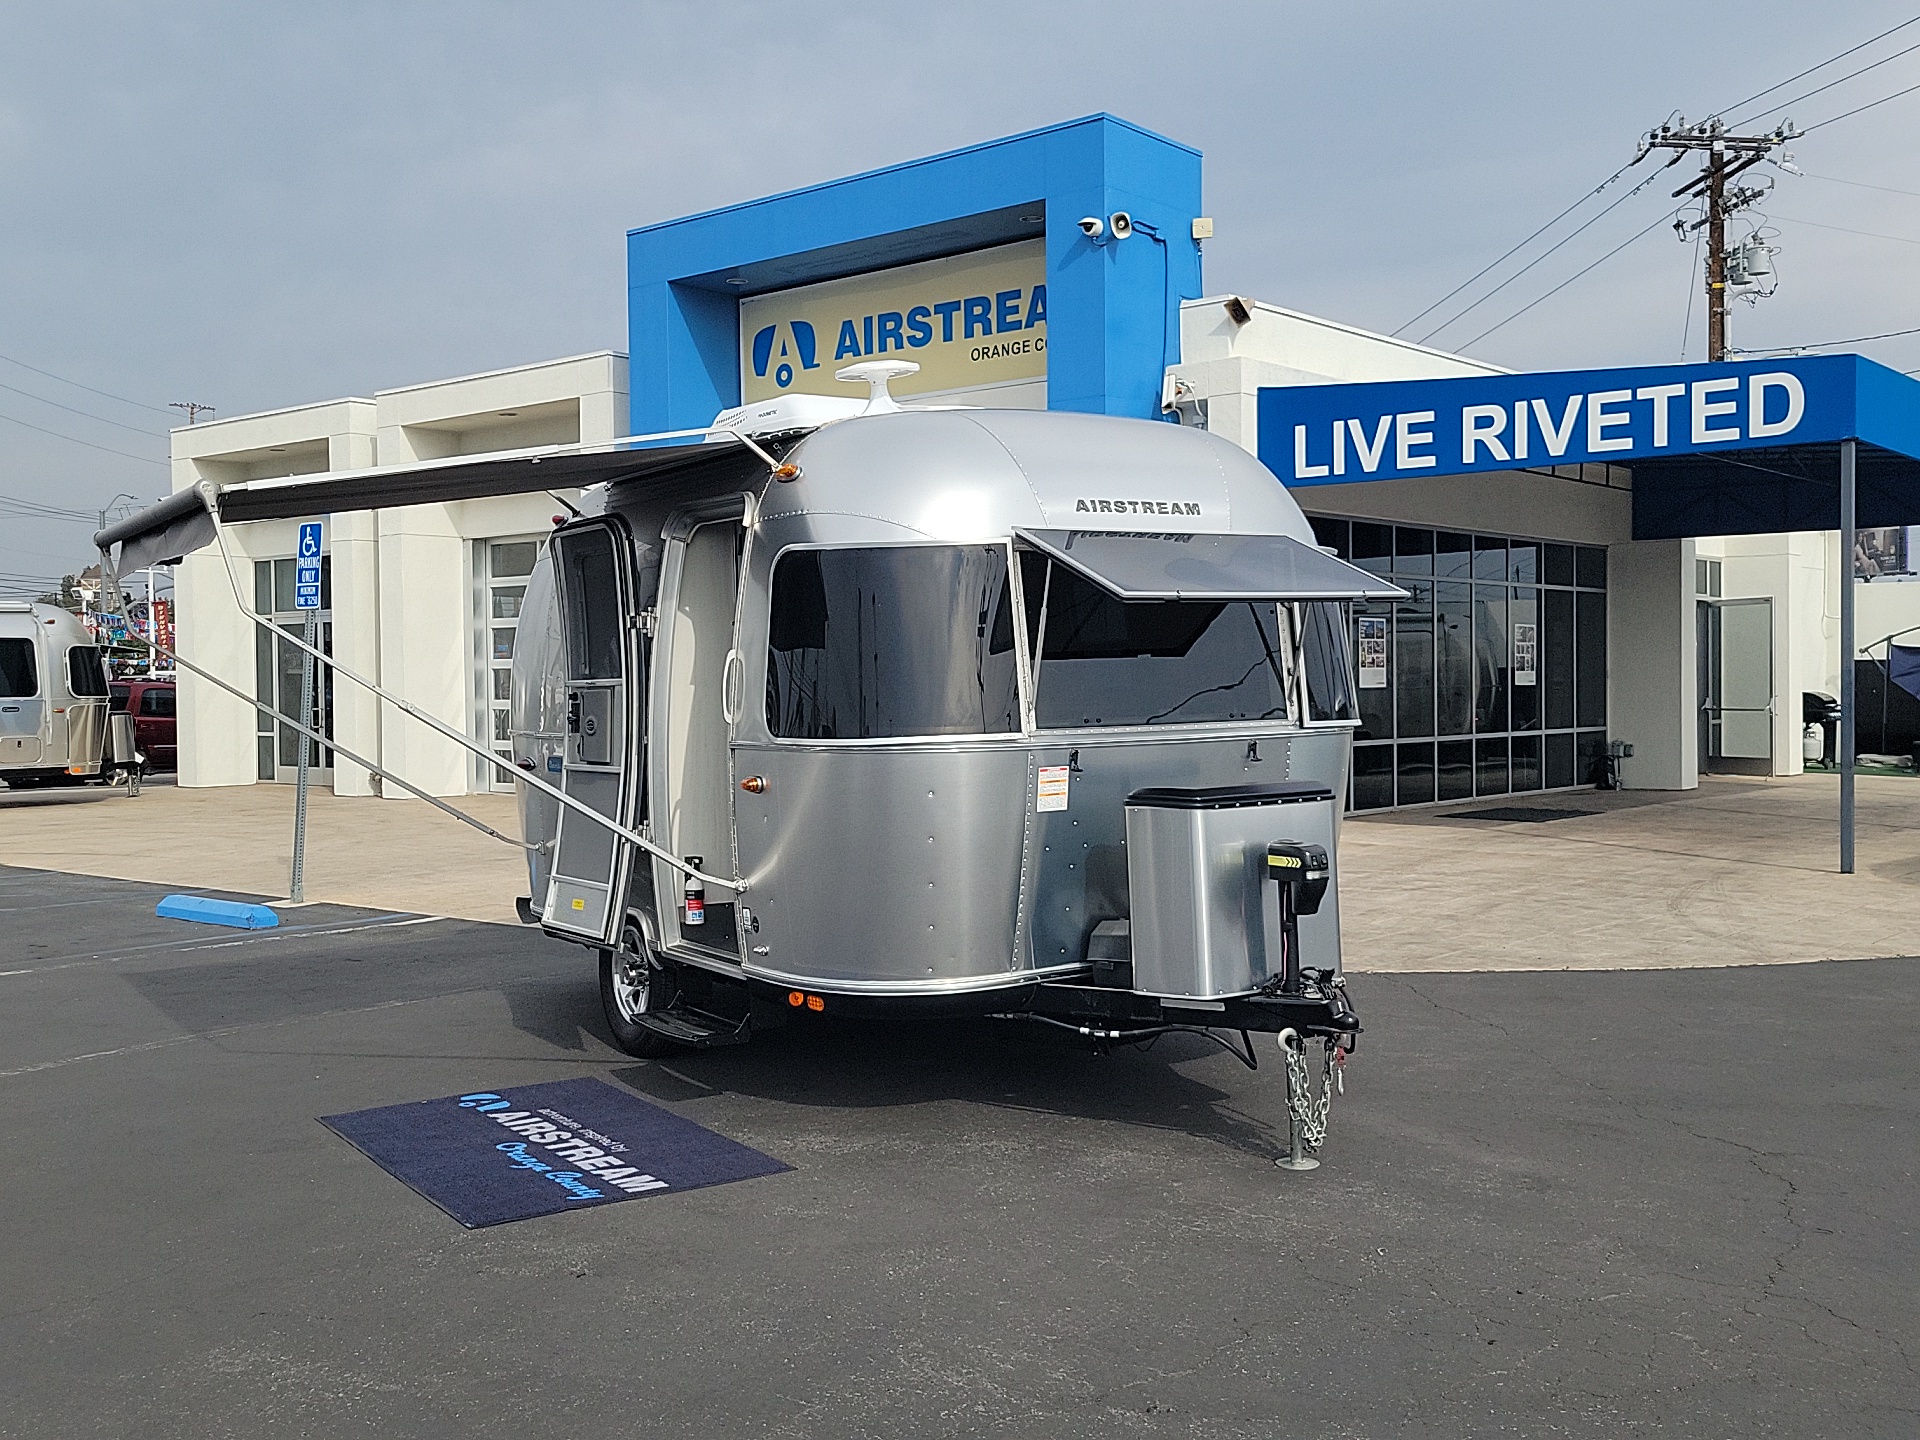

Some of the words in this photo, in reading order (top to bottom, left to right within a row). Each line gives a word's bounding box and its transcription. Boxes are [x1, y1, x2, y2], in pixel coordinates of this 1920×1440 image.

[970, 339, 1031, 361] ORANGE
[1294, 410, 1437, 478] LIVE
[1461, 371, 1806, 464] RIVETED
[1075, 499, 1201, 515] AIRSTREAM
[298, 556, 320, 569] PARKING
[301, 570, 316, 582] ONLY
[158, 605, 168, 658] BIENVENIDS
[486, 1111, 670, 1194] AIRSTREAM
[495, 1142, 552, 1173] Orange
[545, 1171, 606, 1200] County
